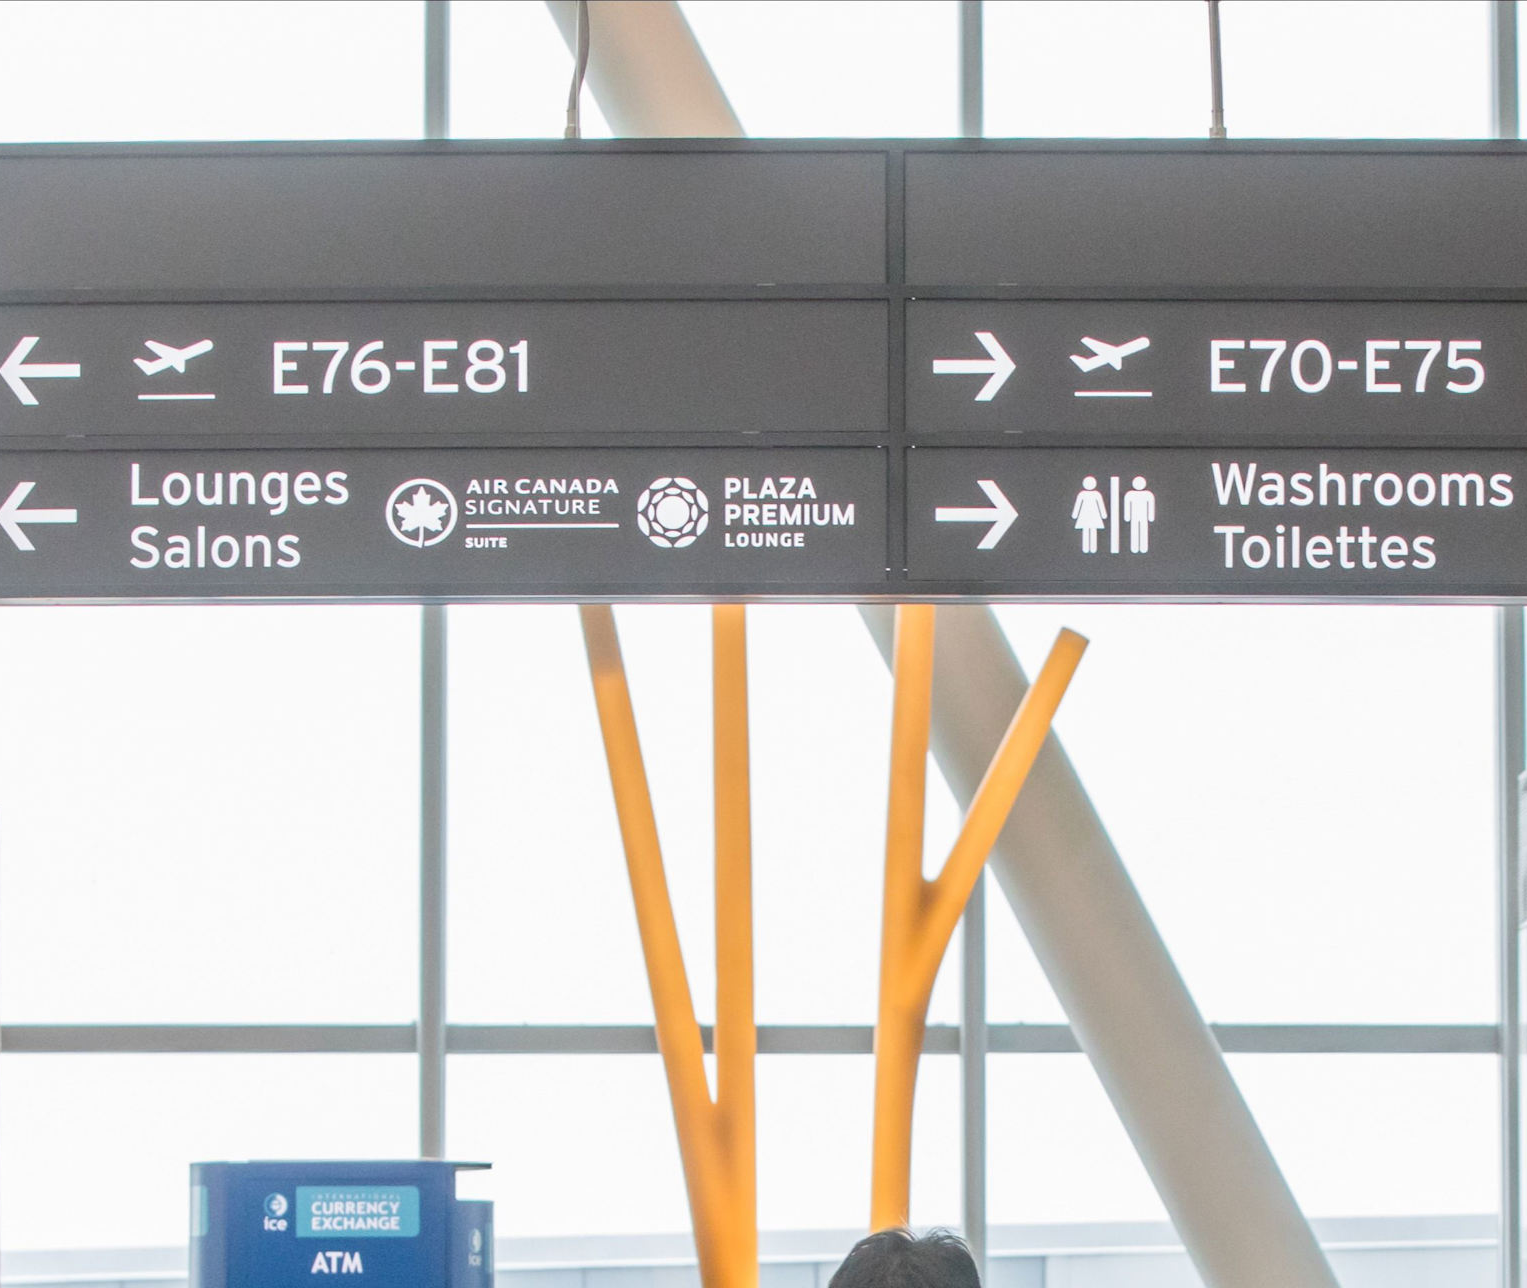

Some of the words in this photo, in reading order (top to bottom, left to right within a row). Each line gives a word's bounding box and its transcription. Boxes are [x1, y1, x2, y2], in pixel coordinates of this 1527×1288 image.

[272, 339, 531, 396] E76-E81
[1210, 339, 1486, 395] E70-E75
[130, 463, 349, 517] Lounges
[466, 480, 506, 495] AIR
[514, 479, 620, 495] CANADA
[725, 477, 817, 500] PLAZA
[1212, 463, 1515, 508] Washrooms
[465, 498, 601, 516] SIGNATURE
[724, 503, 855, 526] PREMIUM
[130, 526, 301, 569] Salons
[464, 536, 509, 549] SUITE
[725, 532, 805, 548] LOUNGE
[1213, 526, 1437, 569] Toilettes
[311, 1201, 400, 1215] CURRENCY
[264, 1217, 287, 1232] ice
[311, 1217, 400, 1230] EXCHANGE
[311, 1252, 363, 1274] ATM
